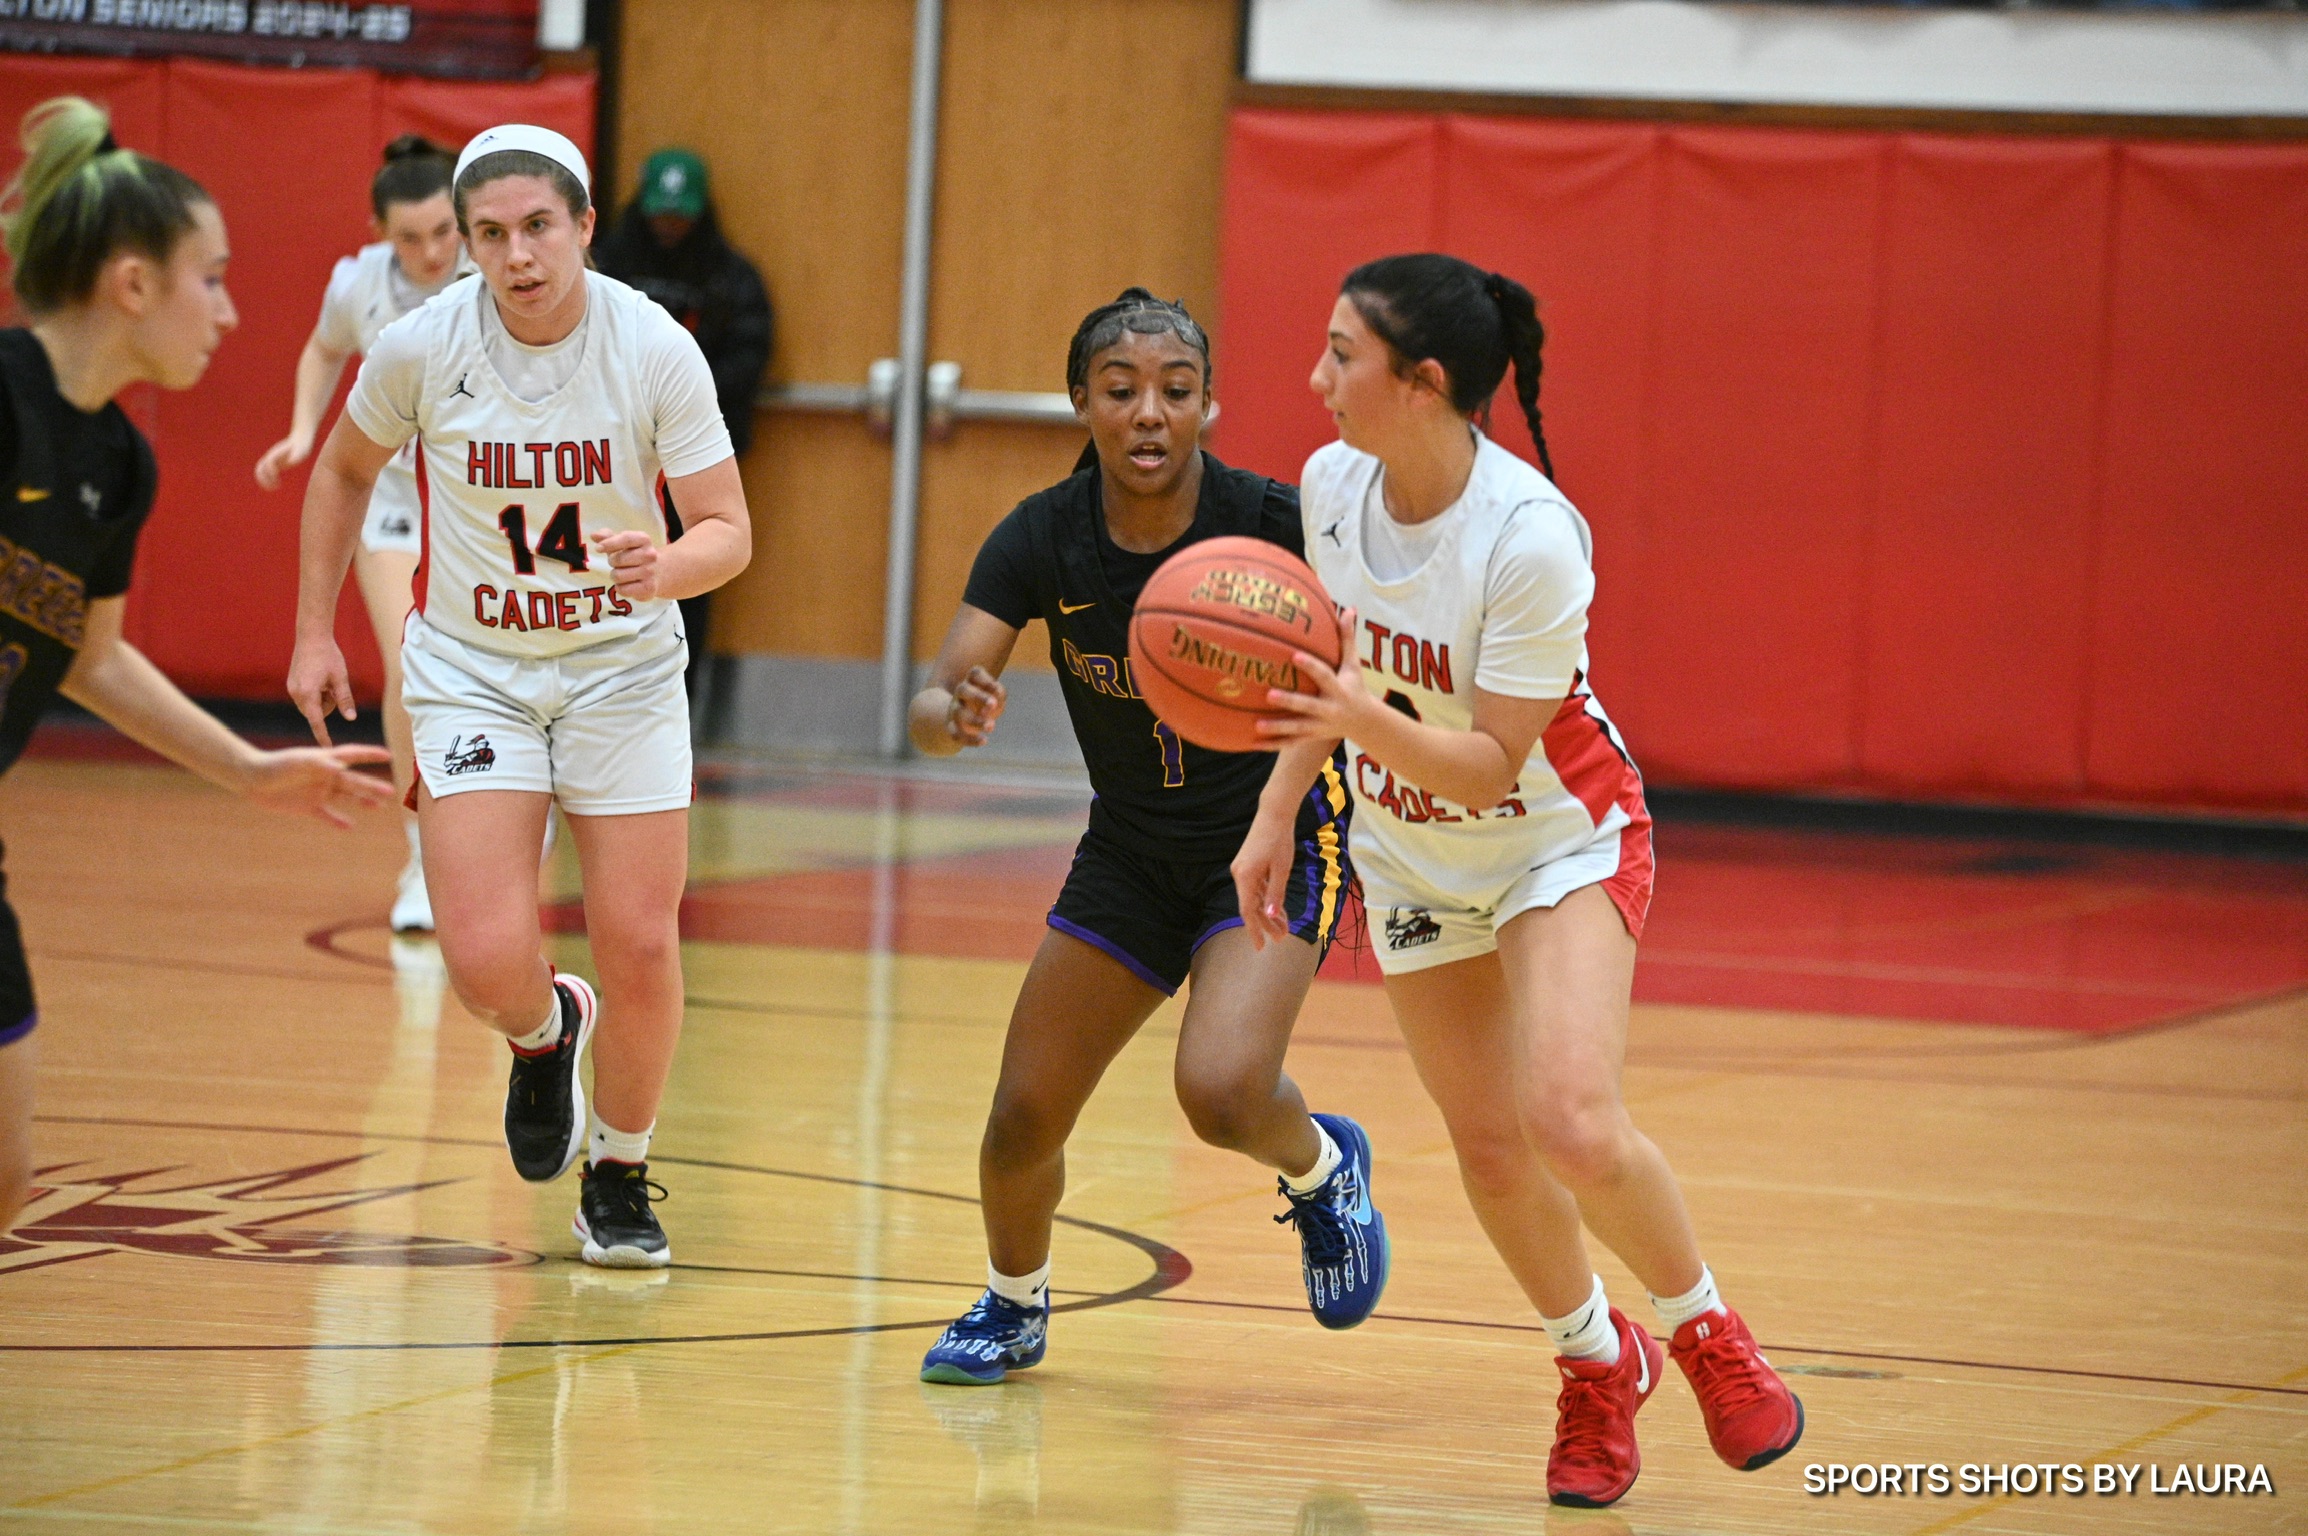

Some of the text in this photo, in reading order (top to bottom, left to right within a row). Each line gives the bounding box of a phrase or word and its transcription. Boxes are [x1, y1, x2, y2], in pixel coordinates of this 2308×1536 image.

[467, 438, 612, 489] HILTON
[498, 501, 590, 576] 14
[473, 583, 633, 632] CADETS
[1153, 718, 1185, 788] 1
